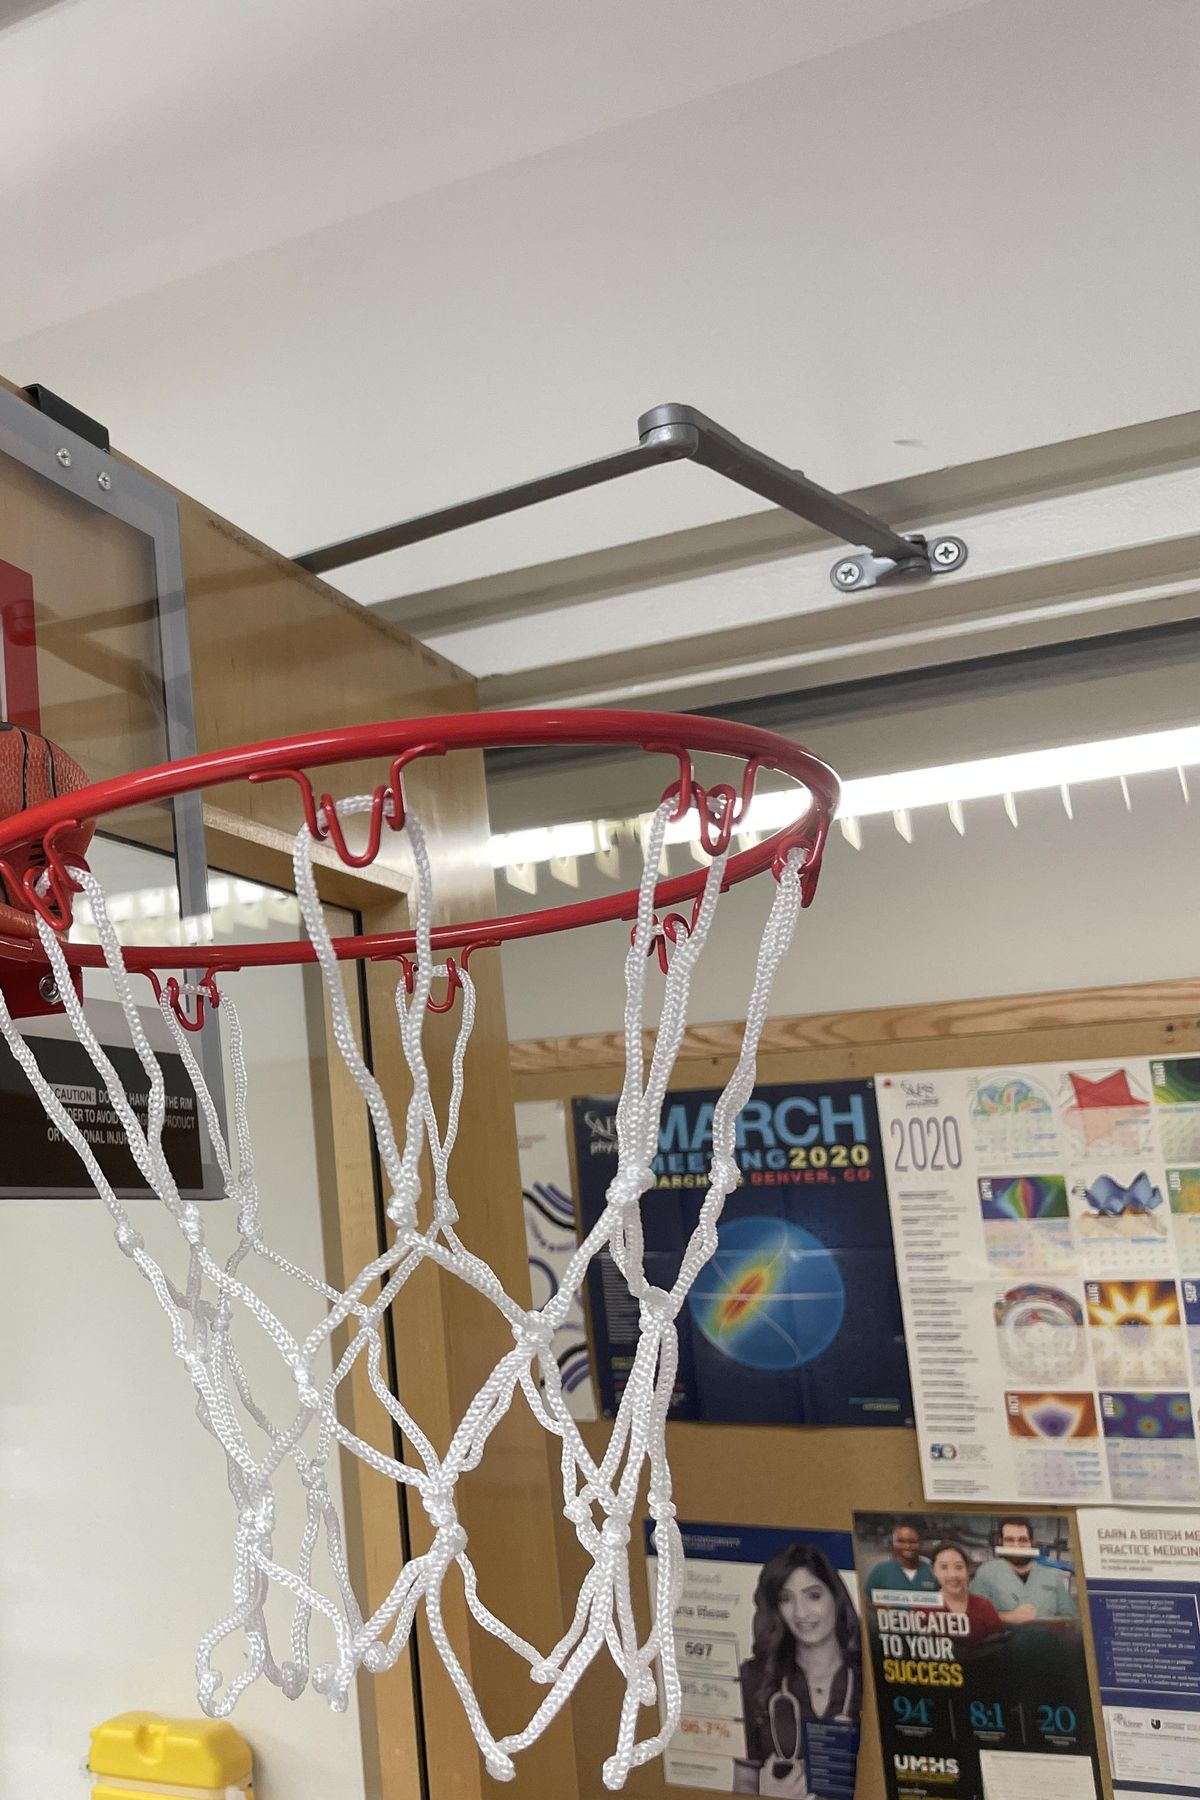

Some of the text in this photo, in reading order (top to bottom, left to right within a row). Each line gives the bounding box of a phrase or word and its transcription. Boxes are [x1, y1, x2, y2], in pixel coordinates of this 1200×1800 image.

[55, 1088, 95, 1102] CAUTION:
[180, 1097, 192, 1110] RIM
[85, 1109, 95, 1123] TO
[97, 1110, 119, 1124] AVOID
[657, 1094, 867, 1152] MARCH
[48, 1128, 59, 1141] OR
[107, 1131, 127, 1144] INJU
[890, 1115, 962, 1172] 2020
[651, 1144, 870, 1174] MEENG 2020
[656, 1173, 708, 1188] ARCH
[751, 1169, 836, 1186] DENVER,
[843, 1167, 871, 1183] CO
[1097, 1528, 1127, 1540] EARN
[1130, 1529, 1138, 1540] A
[1140, 1529, 1182, 1541] BRITISH
[1100, 1544, 1200, 1557] PRACTICE MEDICIN
[877, 1610, 970, 1636] DEDICATED
[879, 1634, 955, 1661] TO YOUR
[883, 1659, 964, 1688] SUCCESS
[1037, 1704, 1077, 1733] 20
[893, 1753, 959, 1775] UMHS
